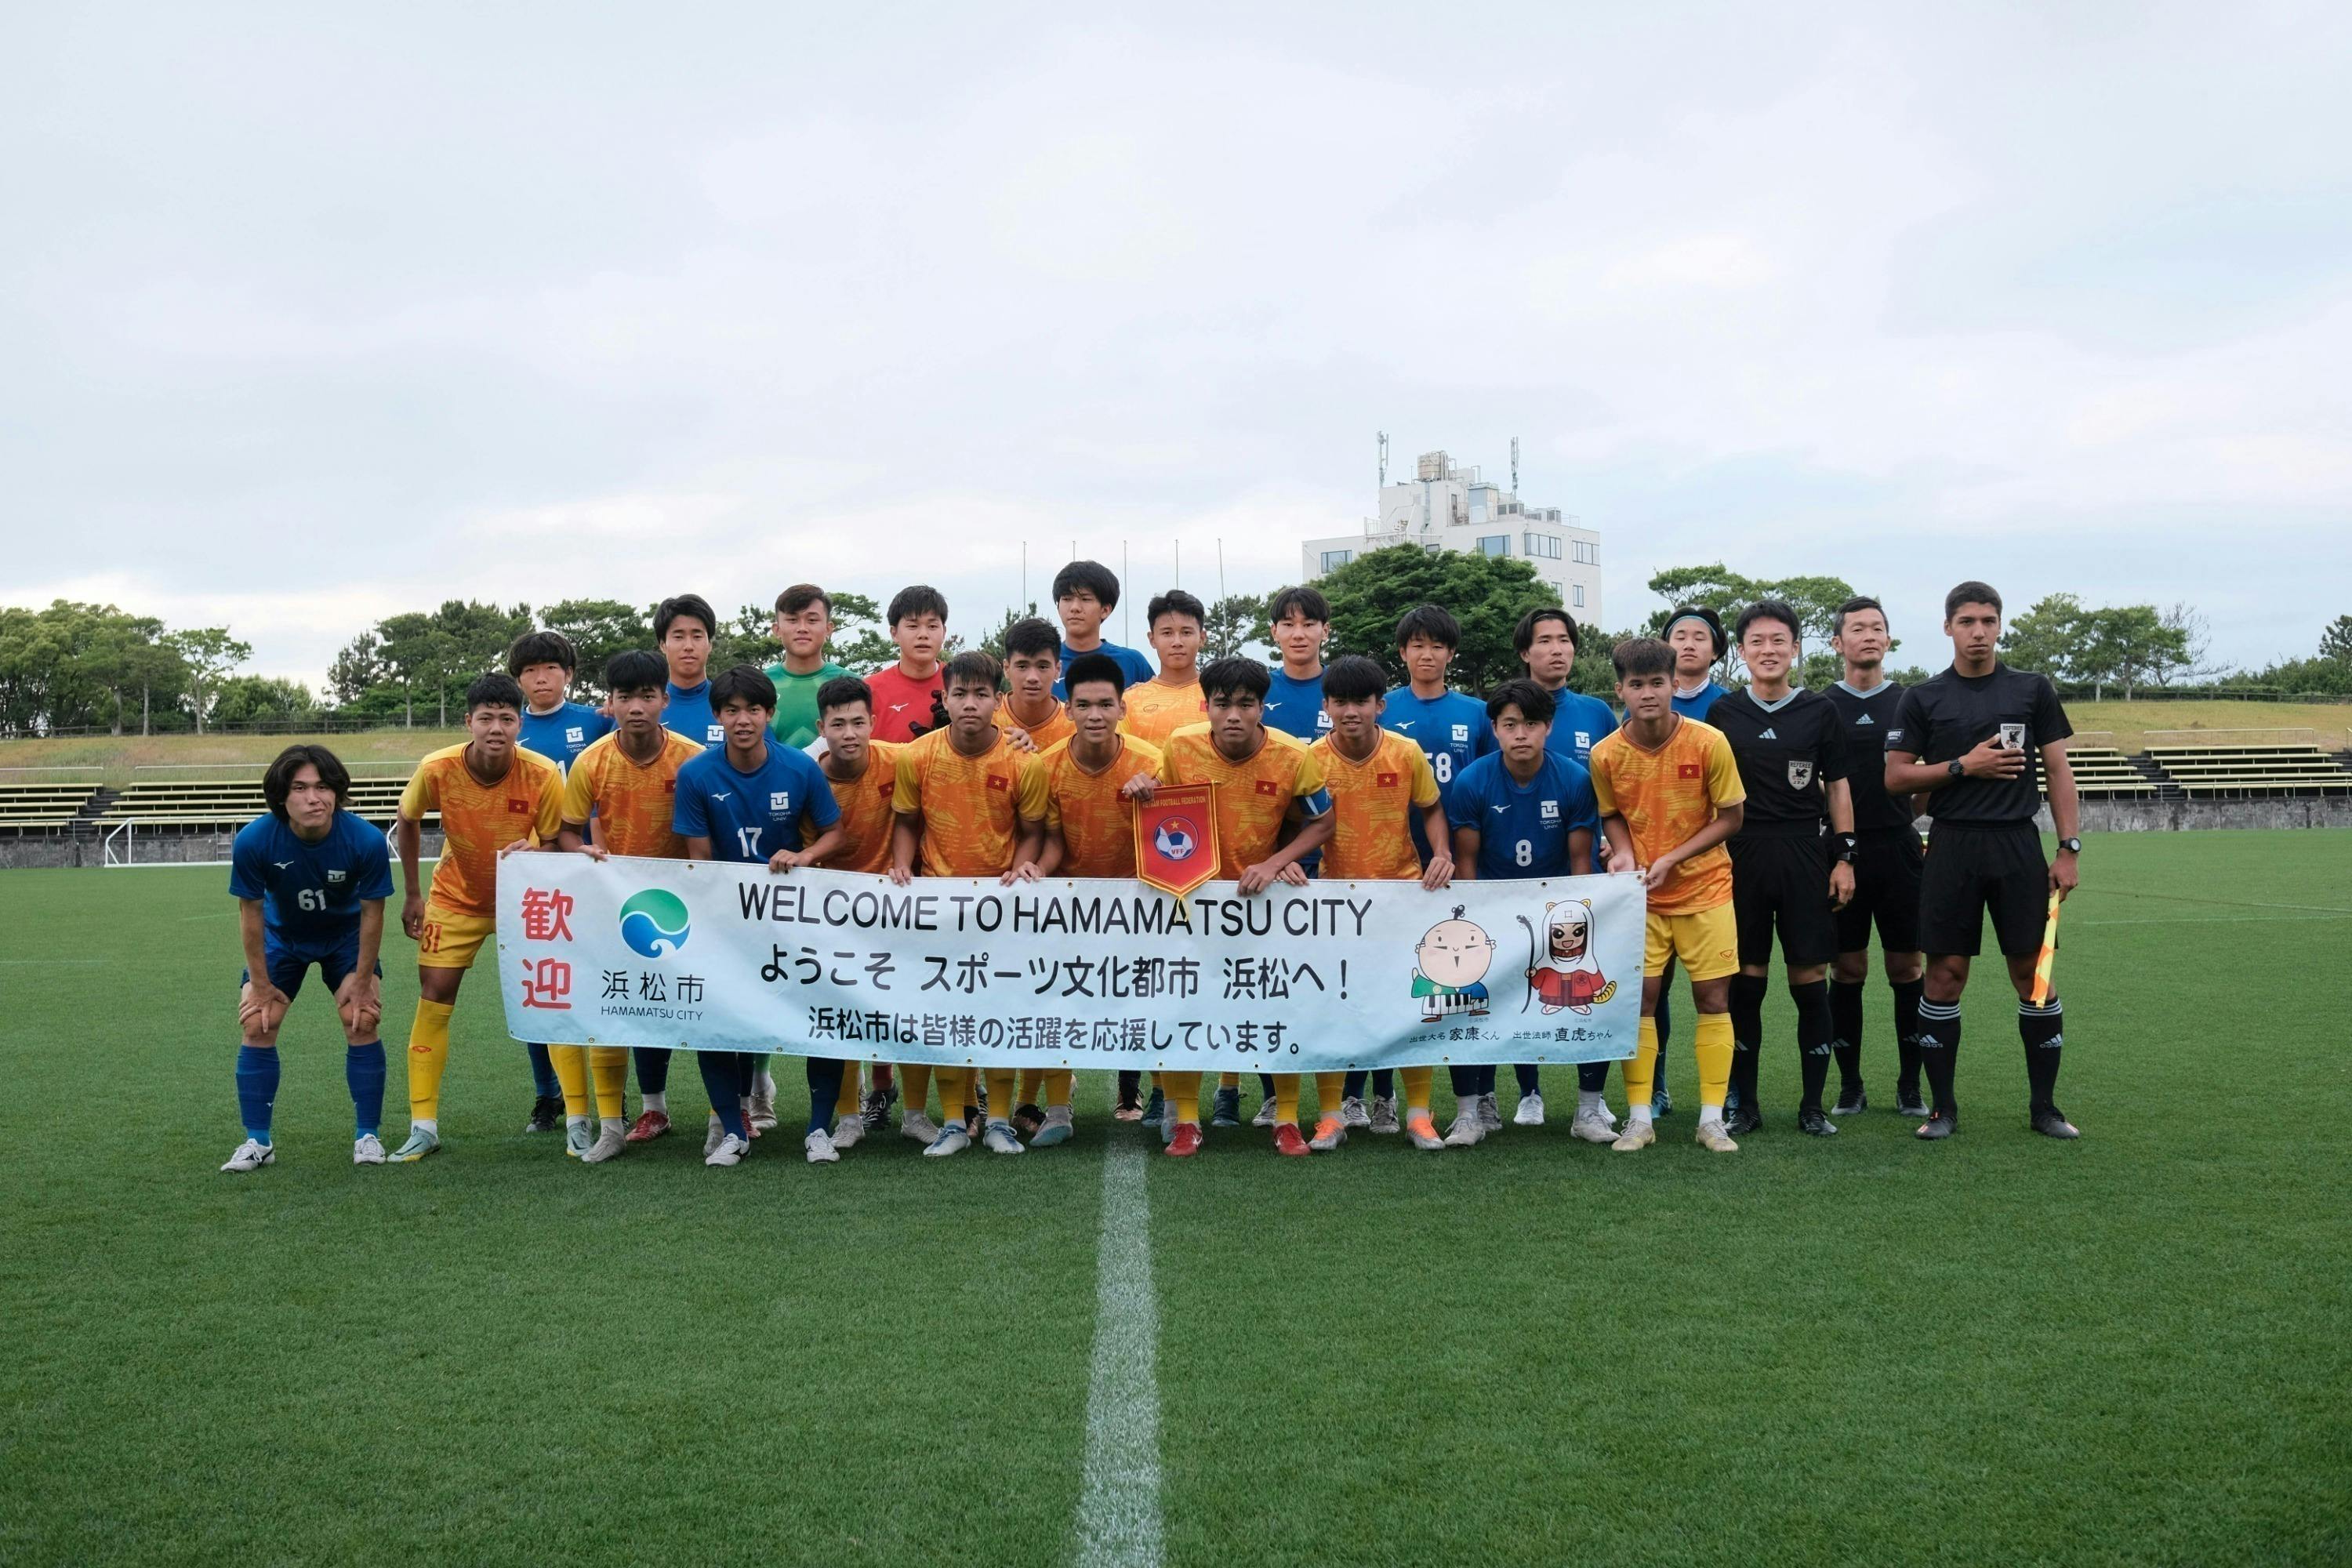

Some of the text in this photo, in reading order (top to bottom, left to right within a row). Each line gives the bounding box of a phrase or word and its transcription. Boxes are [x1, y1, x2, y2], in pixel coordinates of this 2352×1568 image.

[1160, 797, 1181, 807] FOOTBALL
[1181, 796, 1206, 805] FEDERATION
[738, 827, 762, 858] 17
[1515, 839, 1533, 867] 8
[298, 888, 326, 911] 61
[739, 882, 1373, 937] WELCOME TO HAMAMATSU CITY
[421, 924, 442, 953] 31
[760, 943, 896, 991] ようこそ
[920, 951, 1201, 1000] スポーツ文化都市
[601, 969, 706, 1004] 浜松市
[601, 1006, 703, 1021] HAMAMATSU CITY
[808, 1006, 1300, 1055] 浜松市は皆様の活躍を応援しています。
[1410, 1025, 1500, 1043] 出世大名 家康くん
[1512, 1026, 1613, 1042] 出世法師 直虎ちゃん
